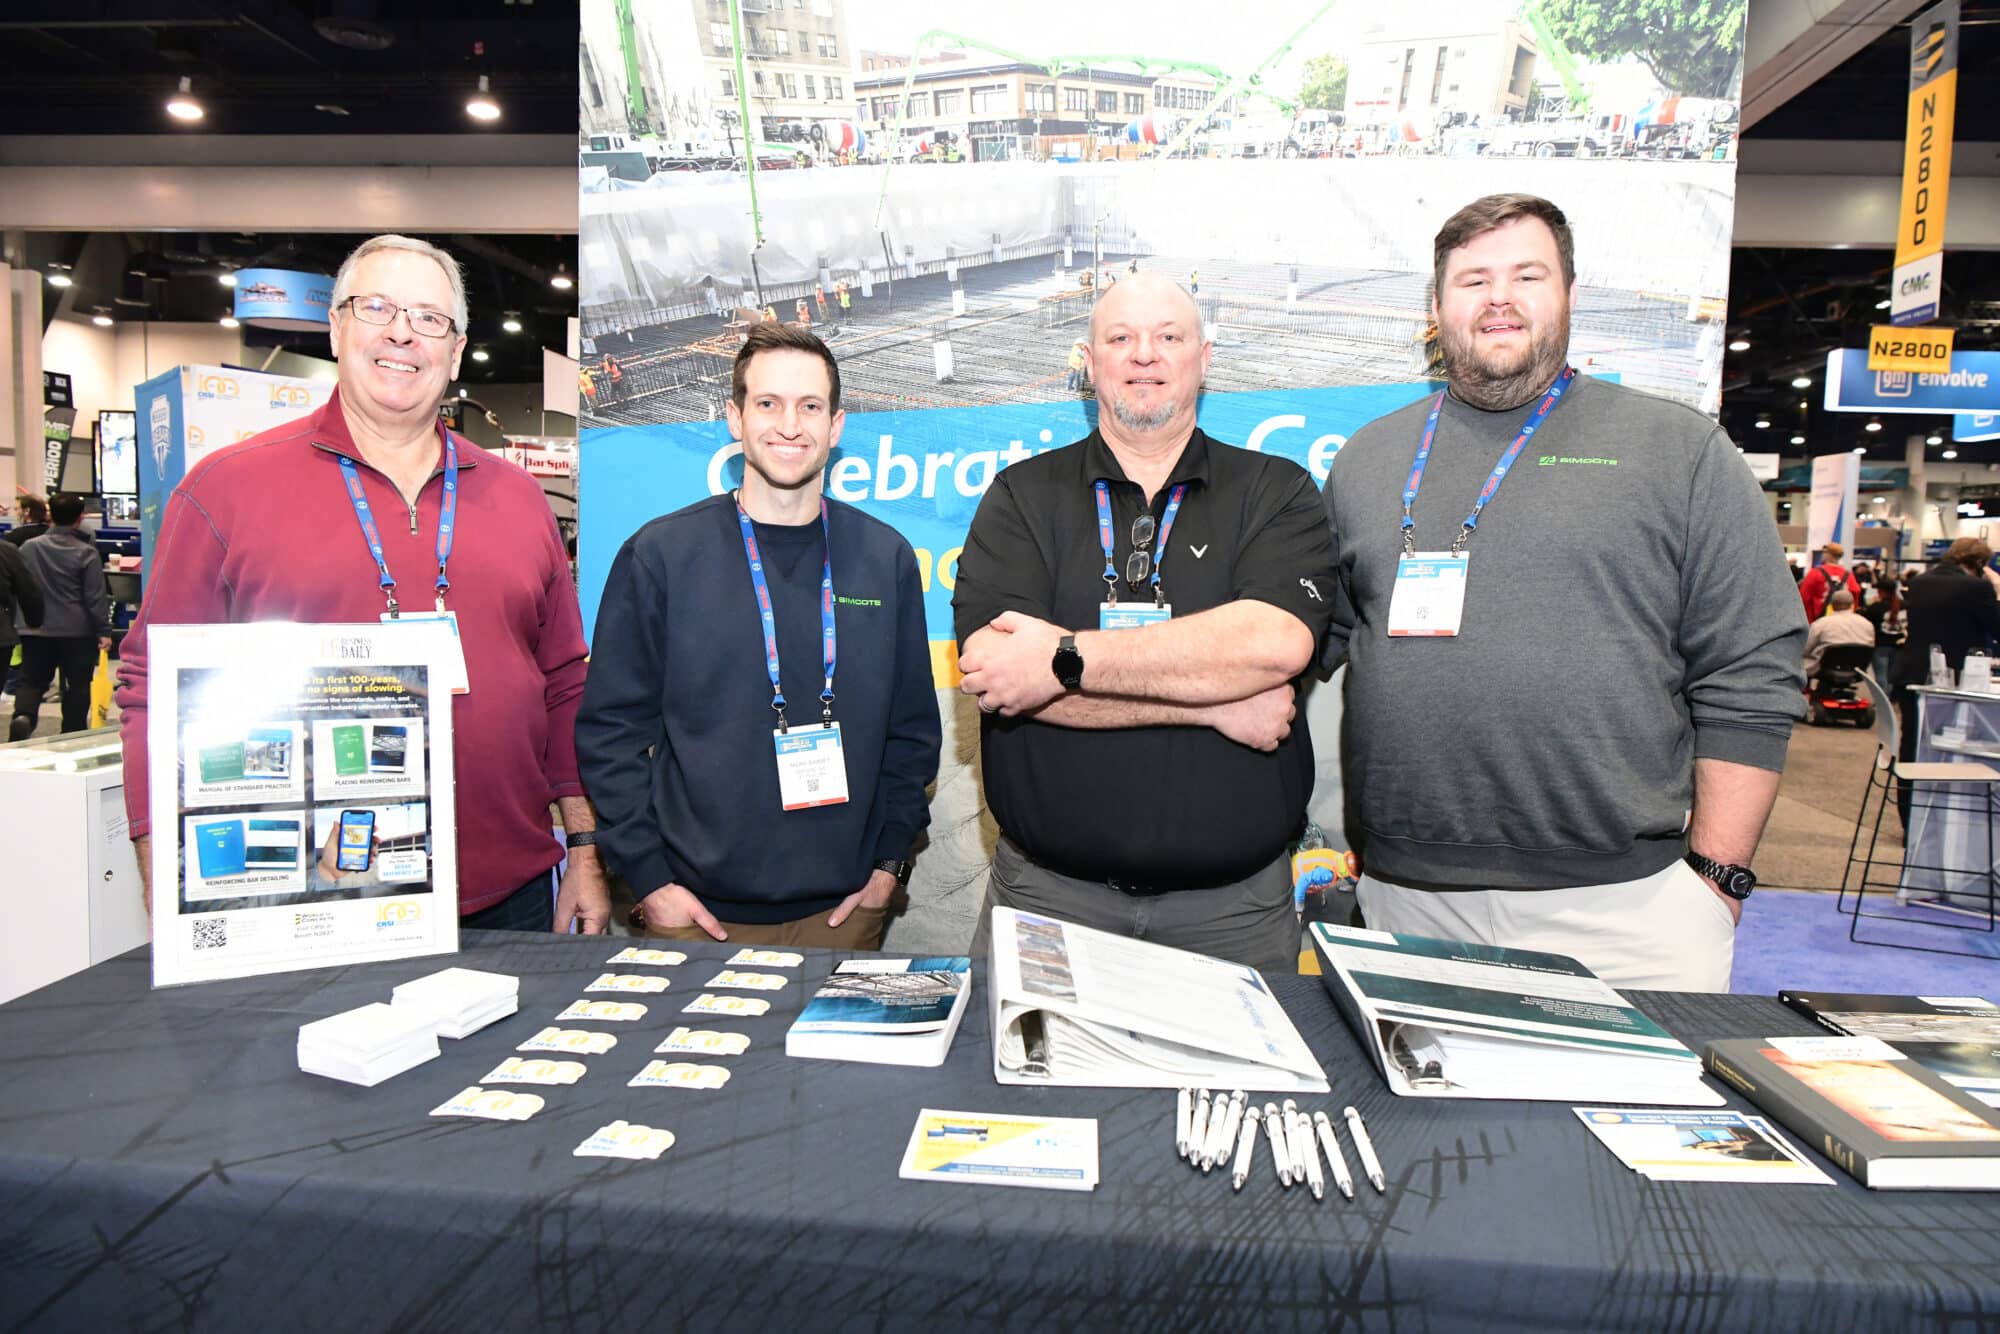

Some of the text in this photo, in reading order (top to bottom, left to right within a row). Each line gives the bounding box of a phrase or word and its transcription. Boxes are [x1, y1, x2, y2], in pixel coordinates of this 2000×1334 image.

[1914, 92, 1936, 246] N2800
[1901, 272, 1930, 296] CMC
[1874, 341, 1947, 360] N2800
[1918, 368, 1988, 388] envolve
[838, 596, 881, 607] SIMCOTE
[341, 645, 372, 659] DAILY
[328, 675, 347, 684] first
[323, 685, 349, 695] signs
[352, 685, 362, 693] of
[365, 685, 406, 694] slowing.
[260, 874, 289, 882] DETAILING
